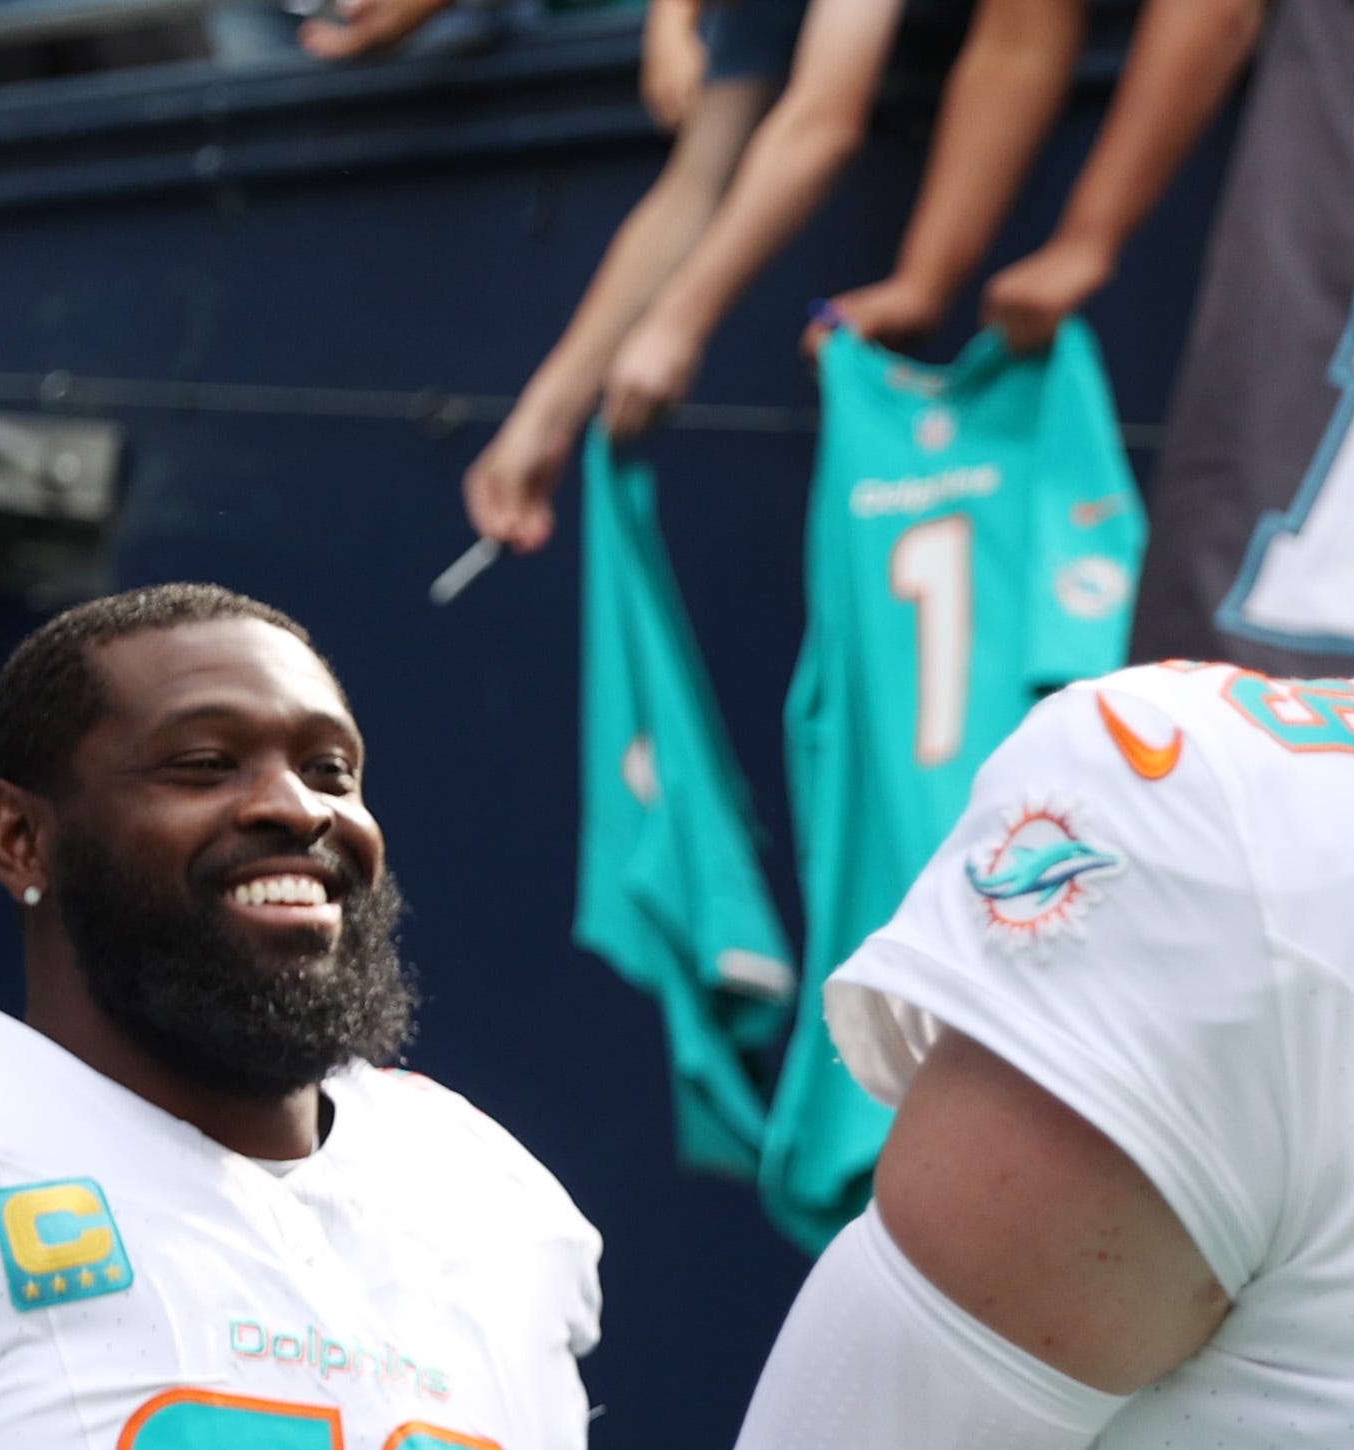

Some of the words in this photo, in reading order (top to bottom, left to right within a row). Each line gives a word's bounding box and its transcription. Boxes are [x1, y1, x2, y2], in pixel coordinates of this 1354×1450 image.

[890, 511, 975, 767] 1
[2, 1184, 114, 1275] C
[230, 1319, 451, 1401] Dolphins
